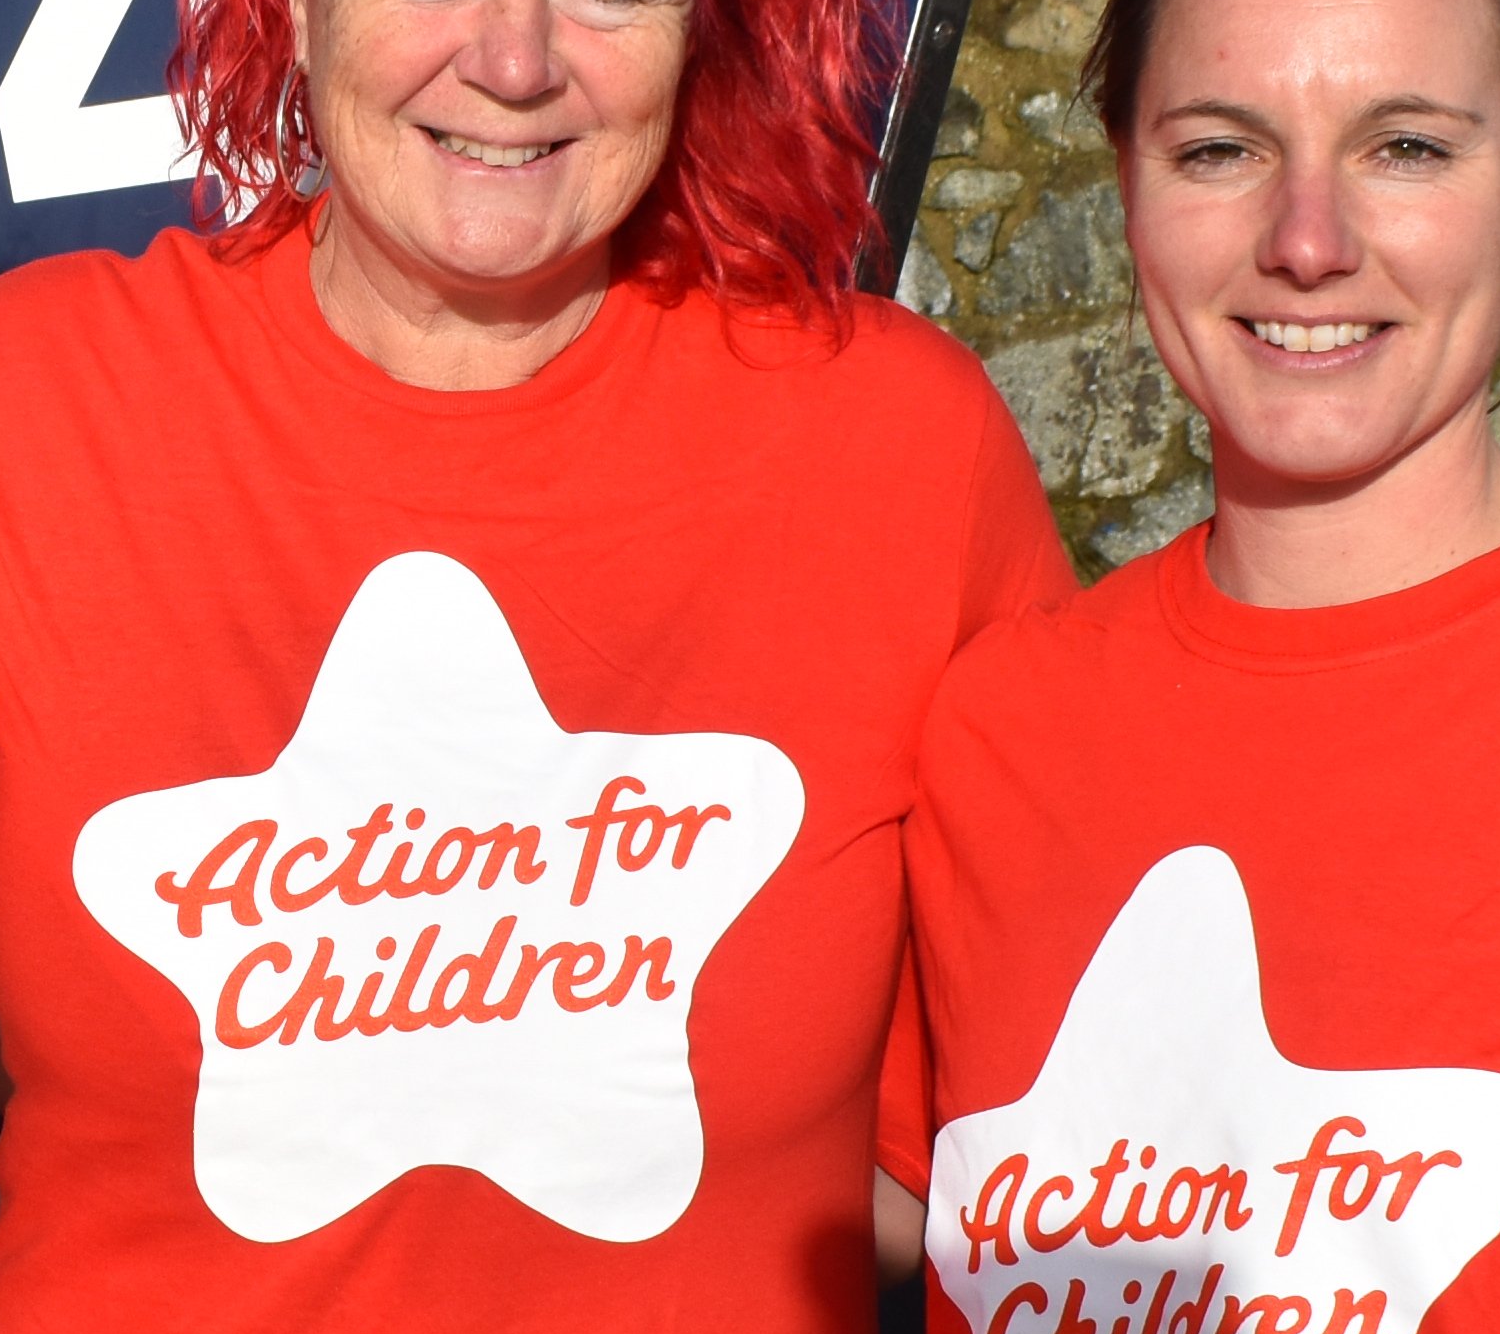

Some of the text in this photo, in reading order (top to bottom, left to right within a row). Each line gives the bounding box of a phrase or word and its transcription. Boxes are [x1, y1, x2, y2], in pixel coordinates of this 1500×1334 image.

[154, 776, 731, 938] Action for
[214, 915, 675, 1049] Children
[960, 1116, 1462, 1274] Action for
